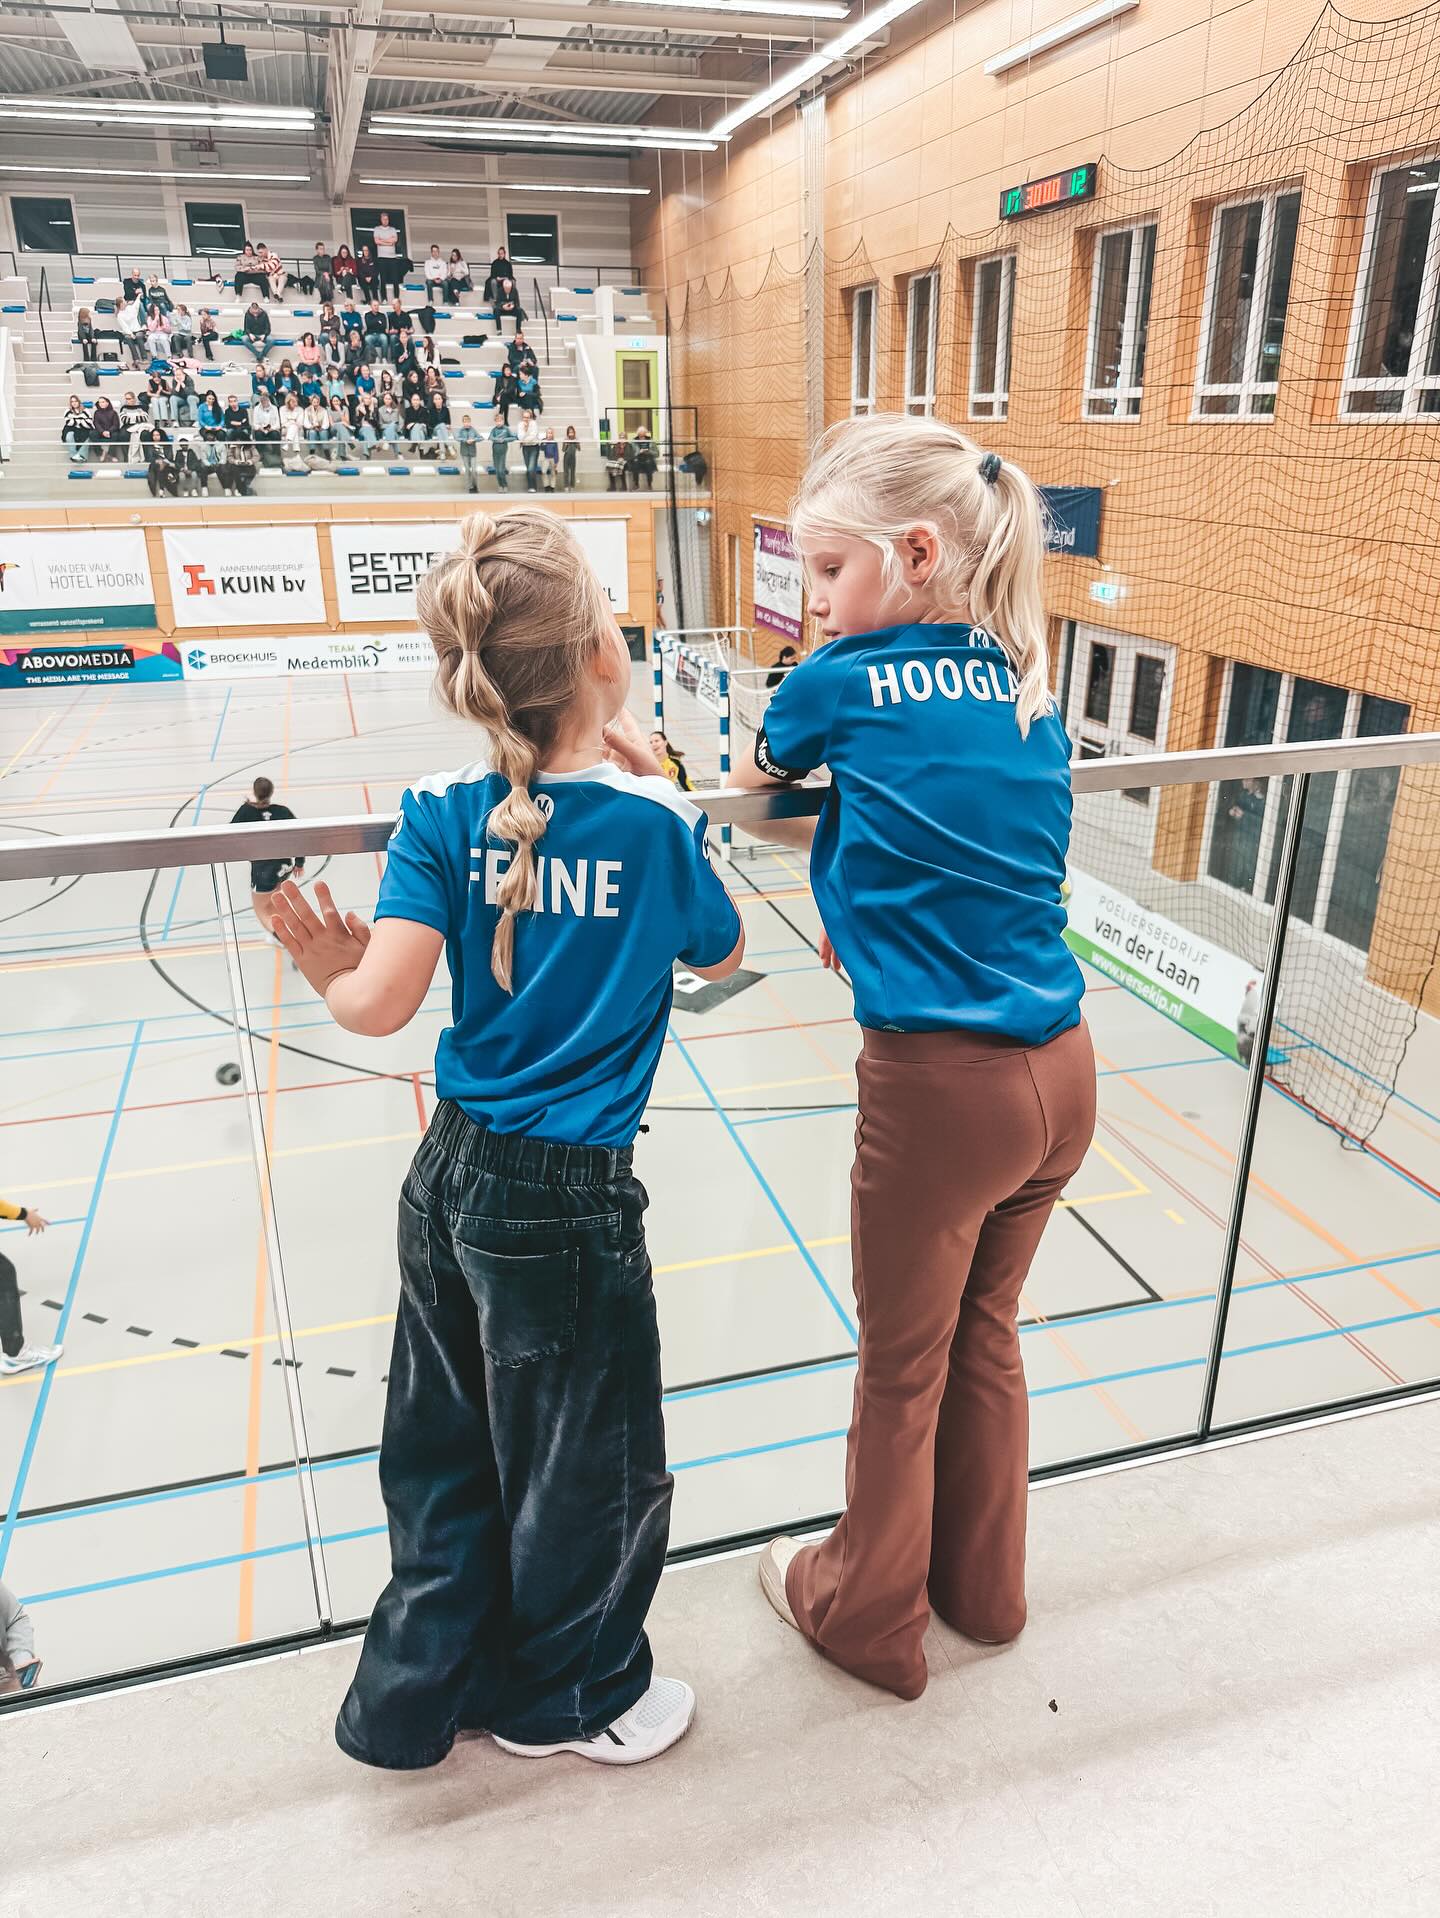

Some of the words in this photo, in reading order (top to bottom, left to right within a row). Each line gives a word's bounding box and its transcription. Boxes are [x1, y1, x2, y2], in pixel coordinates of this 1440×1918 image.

[1070, 168, 1087, 196] 12
[48, 564, 67, 574] VAN
[68, 563, 87, 574] DER
[89, 562, 112, 573] VALK
[220, 563, 304, 573] AANNEMINGSBEDRIJF
[49, 575, 94, 589] HOTEL
[96, 572, 145, 587] HOORN
[221, 575, 275, 594] KUIN
[282, 575, 305, 592] bv
[350, 574, 425, 594] 202
[328, 644, 355, 653] TEAM
[21, 652, 131, 669] ABOVOMEDIA
[210, 652, 277, 664] BROEKHUIS
[287, 654, 370, 670] Medemblik
[26, 676, 42, 684] THE
[42, 675, 66, 683] MEDIA
[81, 673, 97, 681] THE
[1099, 895, 1209, 966] POELIERSBEDRIJF
[1094, 916, 1122, 946] van
[1125, 935, 1153, 966] der
[1156, 951, 1200, 995] Laan
[1091, 951, 1184, 1020] www.versekip.nl
